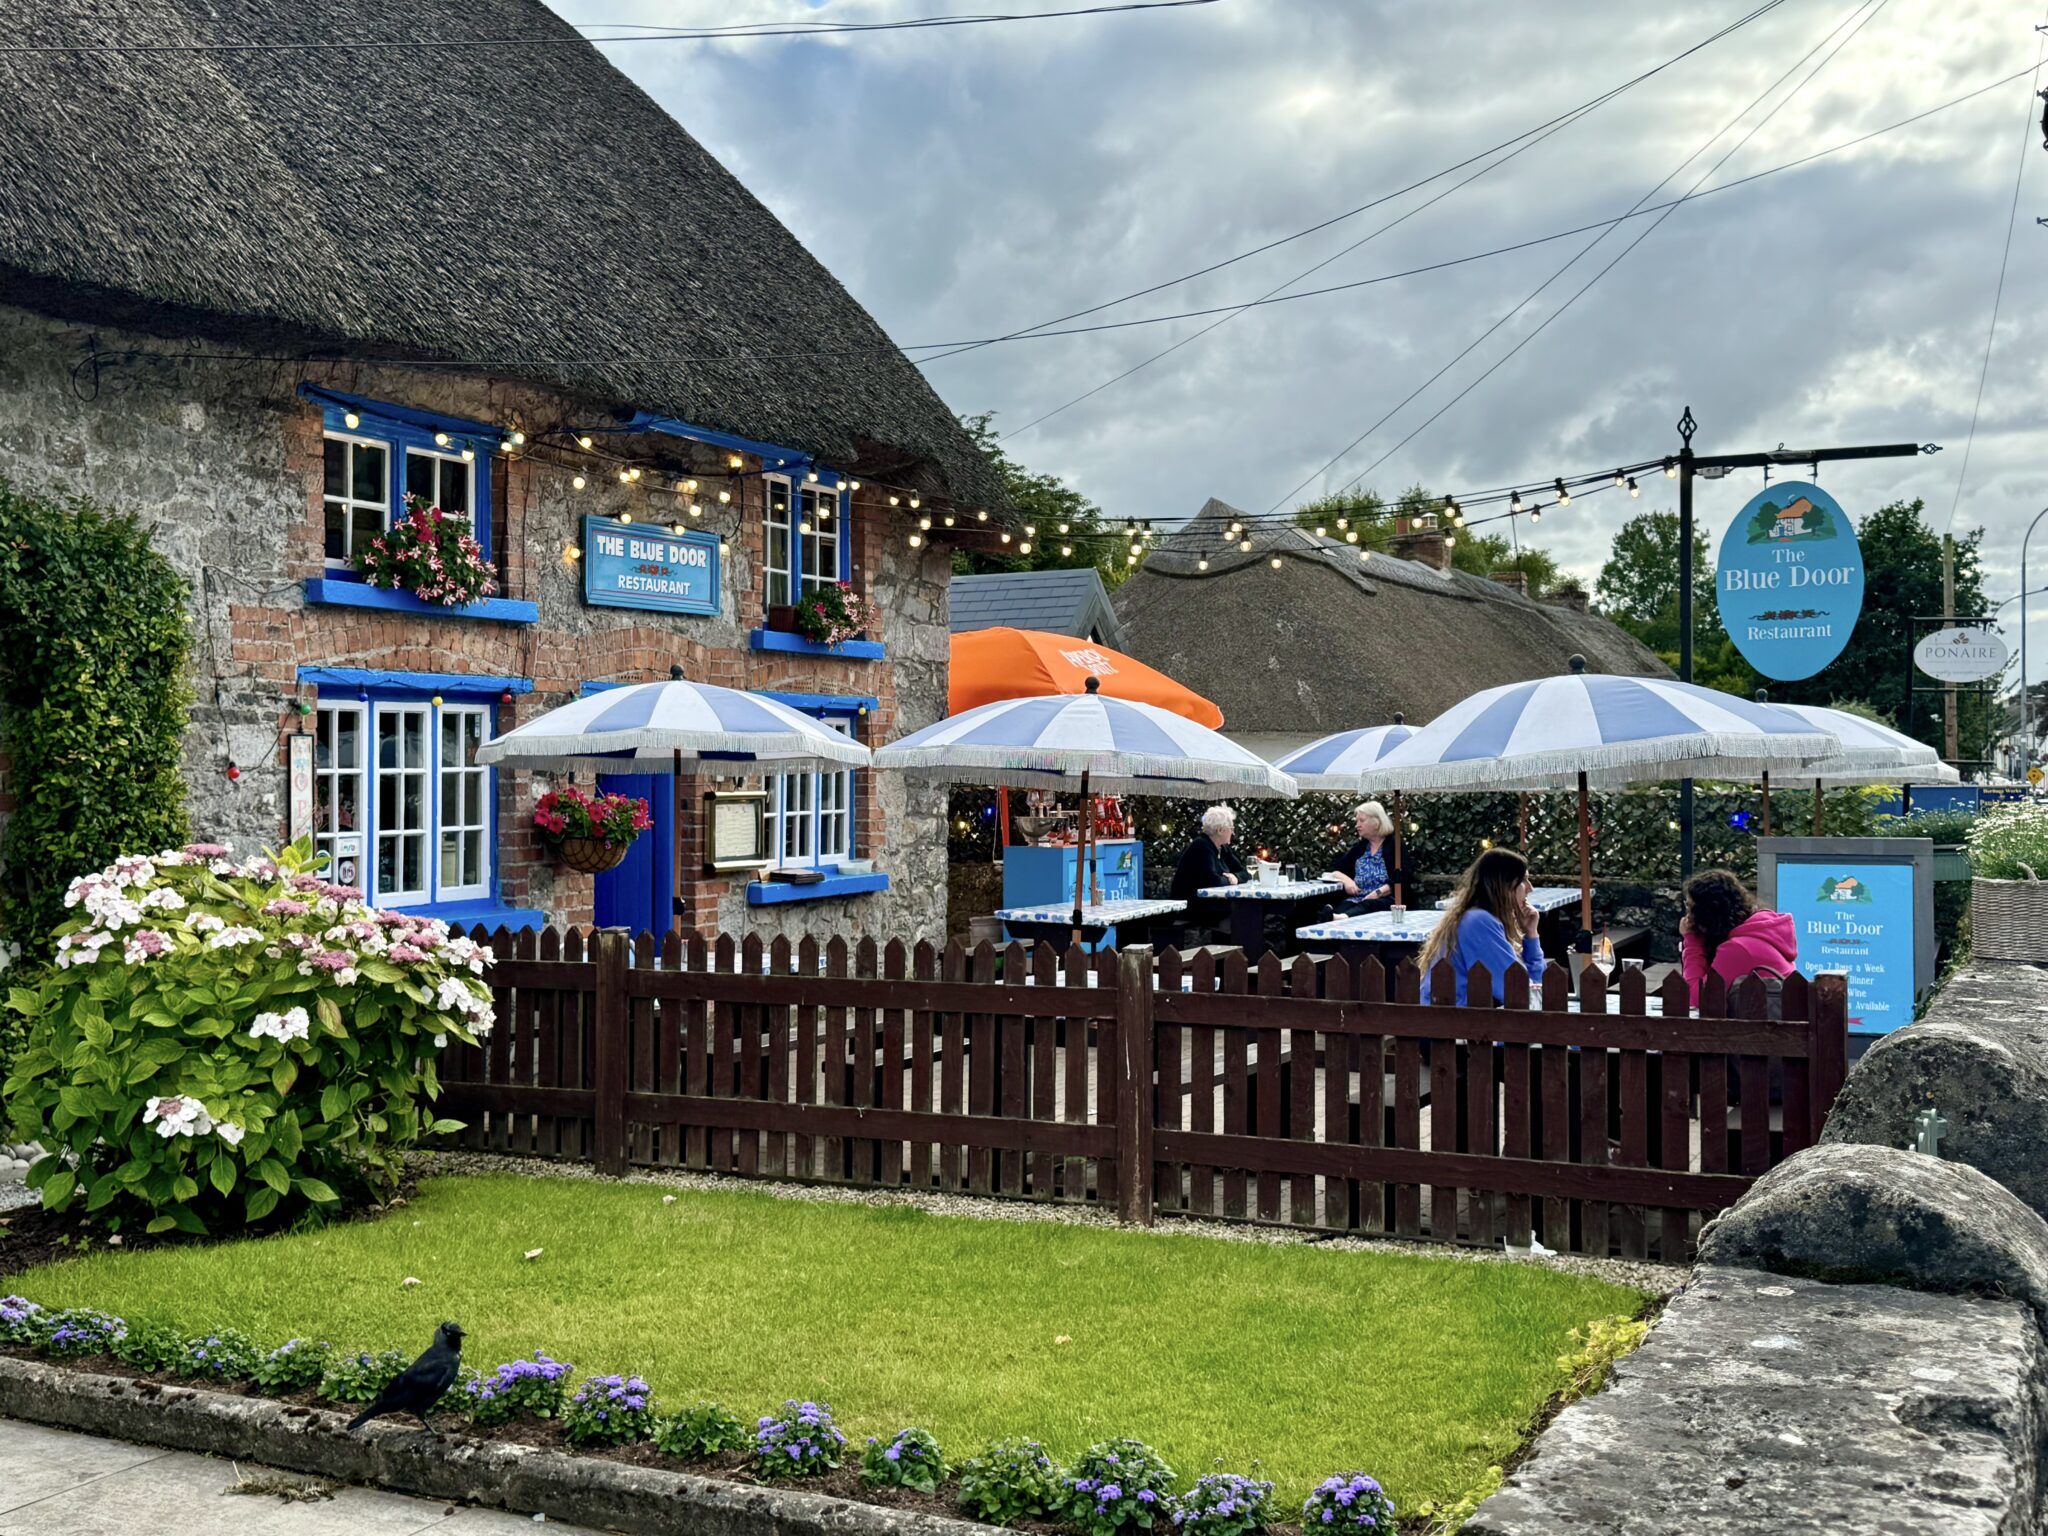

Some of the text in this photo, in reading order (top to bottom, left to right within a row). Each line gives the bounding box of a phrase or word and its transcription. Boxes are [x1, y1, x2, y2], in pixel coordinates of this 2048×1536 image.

[597, 535, 706, 568] THE BLUE DOOR
[1772, 549, 1805, 563] The
[1724, 565, 1855, 591] Blue Door
[618, 575, 691, 595] RESTAURANT
[1748, 624, 1832, 641] Restaurant
[1925, 647, 1996, 658] PONAIRE
[1835, 911, 1855, 921] The
[1807, 921, 1883, 935] Blue Door
[1821, 946, 1869, 955] Restaurant
[1805, 962, 1824, 972] Open
[1827, 962, 1832, 970] 7
[1864, 963, 1885, 973] Week
[1850, 976, 1874, 985] Dinner
[1848, 988, 1867, 997] Wine
[1856, 1002, 1890, 1011] Available
